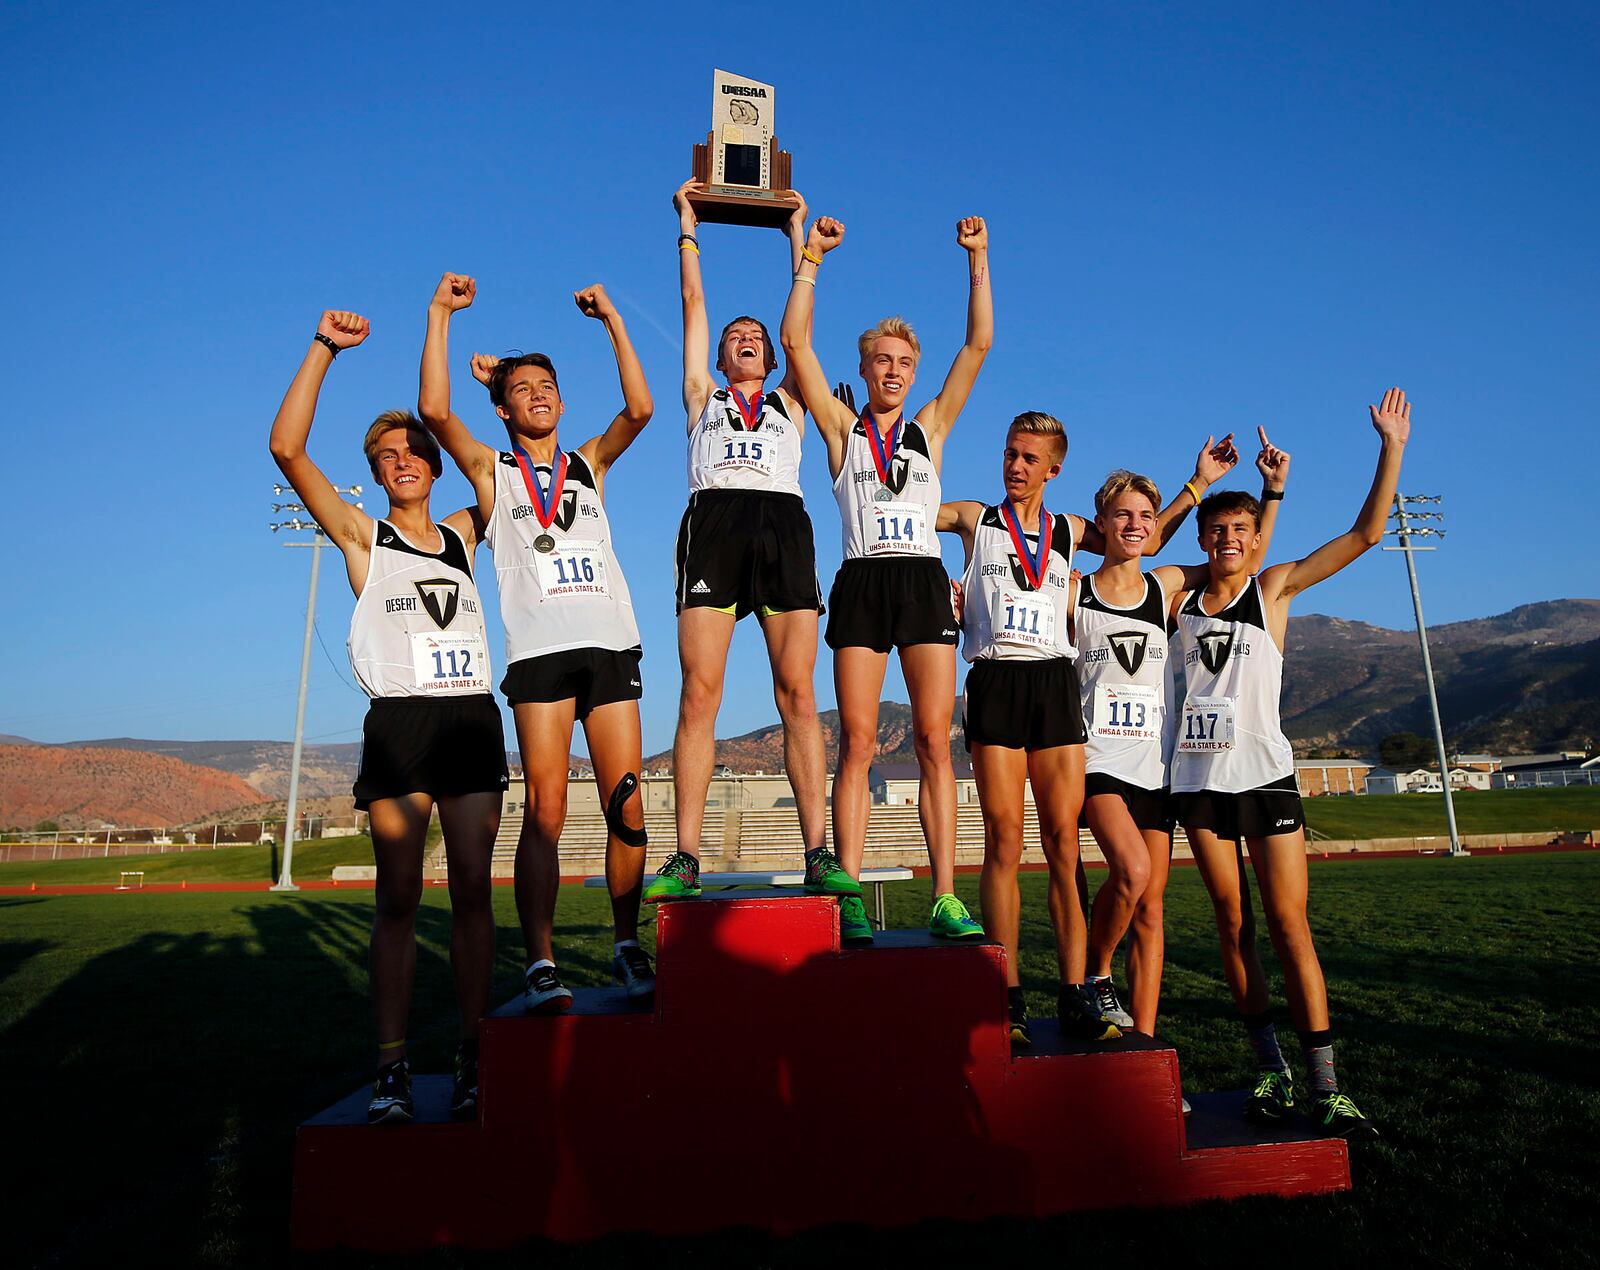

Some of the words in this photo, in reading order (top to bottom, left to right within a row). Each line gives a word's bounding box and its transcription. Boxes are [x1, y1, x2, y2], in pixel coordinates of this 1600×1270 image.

[724, 441, 763, 460] 115
[713, 459, 737, 469] UHSAA
[738, 459, 759, 467] STATE
[760, 461, 771, 473] X-C
[853, 470, 877, 484] DESERT
[912, 471, 929, 483] HILLS
[511, 504, 534, 520] DESER
[877, 516, 914, 541] 114
[869, 542, 891, 552] UHSAA
[893, 542, 911, 550] STATE
[913, 544, 924, 552] X-C
[553, 557, 595, 584] 116
[982, 564, 1008, 577] DESERT
[1048, 572, 1065, 588] HILLS
[548, 586, 573, 595] UHSAA
[575, 585, 593, 593] STATE
[385, 597, 417, 613] DESERT
[461, 599, 477, 613] HILLS
[1004, 605, 1040, 634] 111
[994, 632, 1016, 640] UHSAA
[1018, 634, 1036, 643] STATE
[1037, 636, 1049, 645] X-C
[1085, 648, 1110, 663] DESERT
[1148, 647, 1163, 659] HILLS
[431, 650, 473, 678] 112
[423, 681, 449, 690] UHSAA
[451, 680, 471, 688] STATE
[1108, 701, 1146, 727] 113
[1122, 729, 1142, 737] STATE
[1185, 713, 1218, 739] 117
[1197, 741, 1216, 750] STATE
[1217, 741, 1231, 750] X-C
